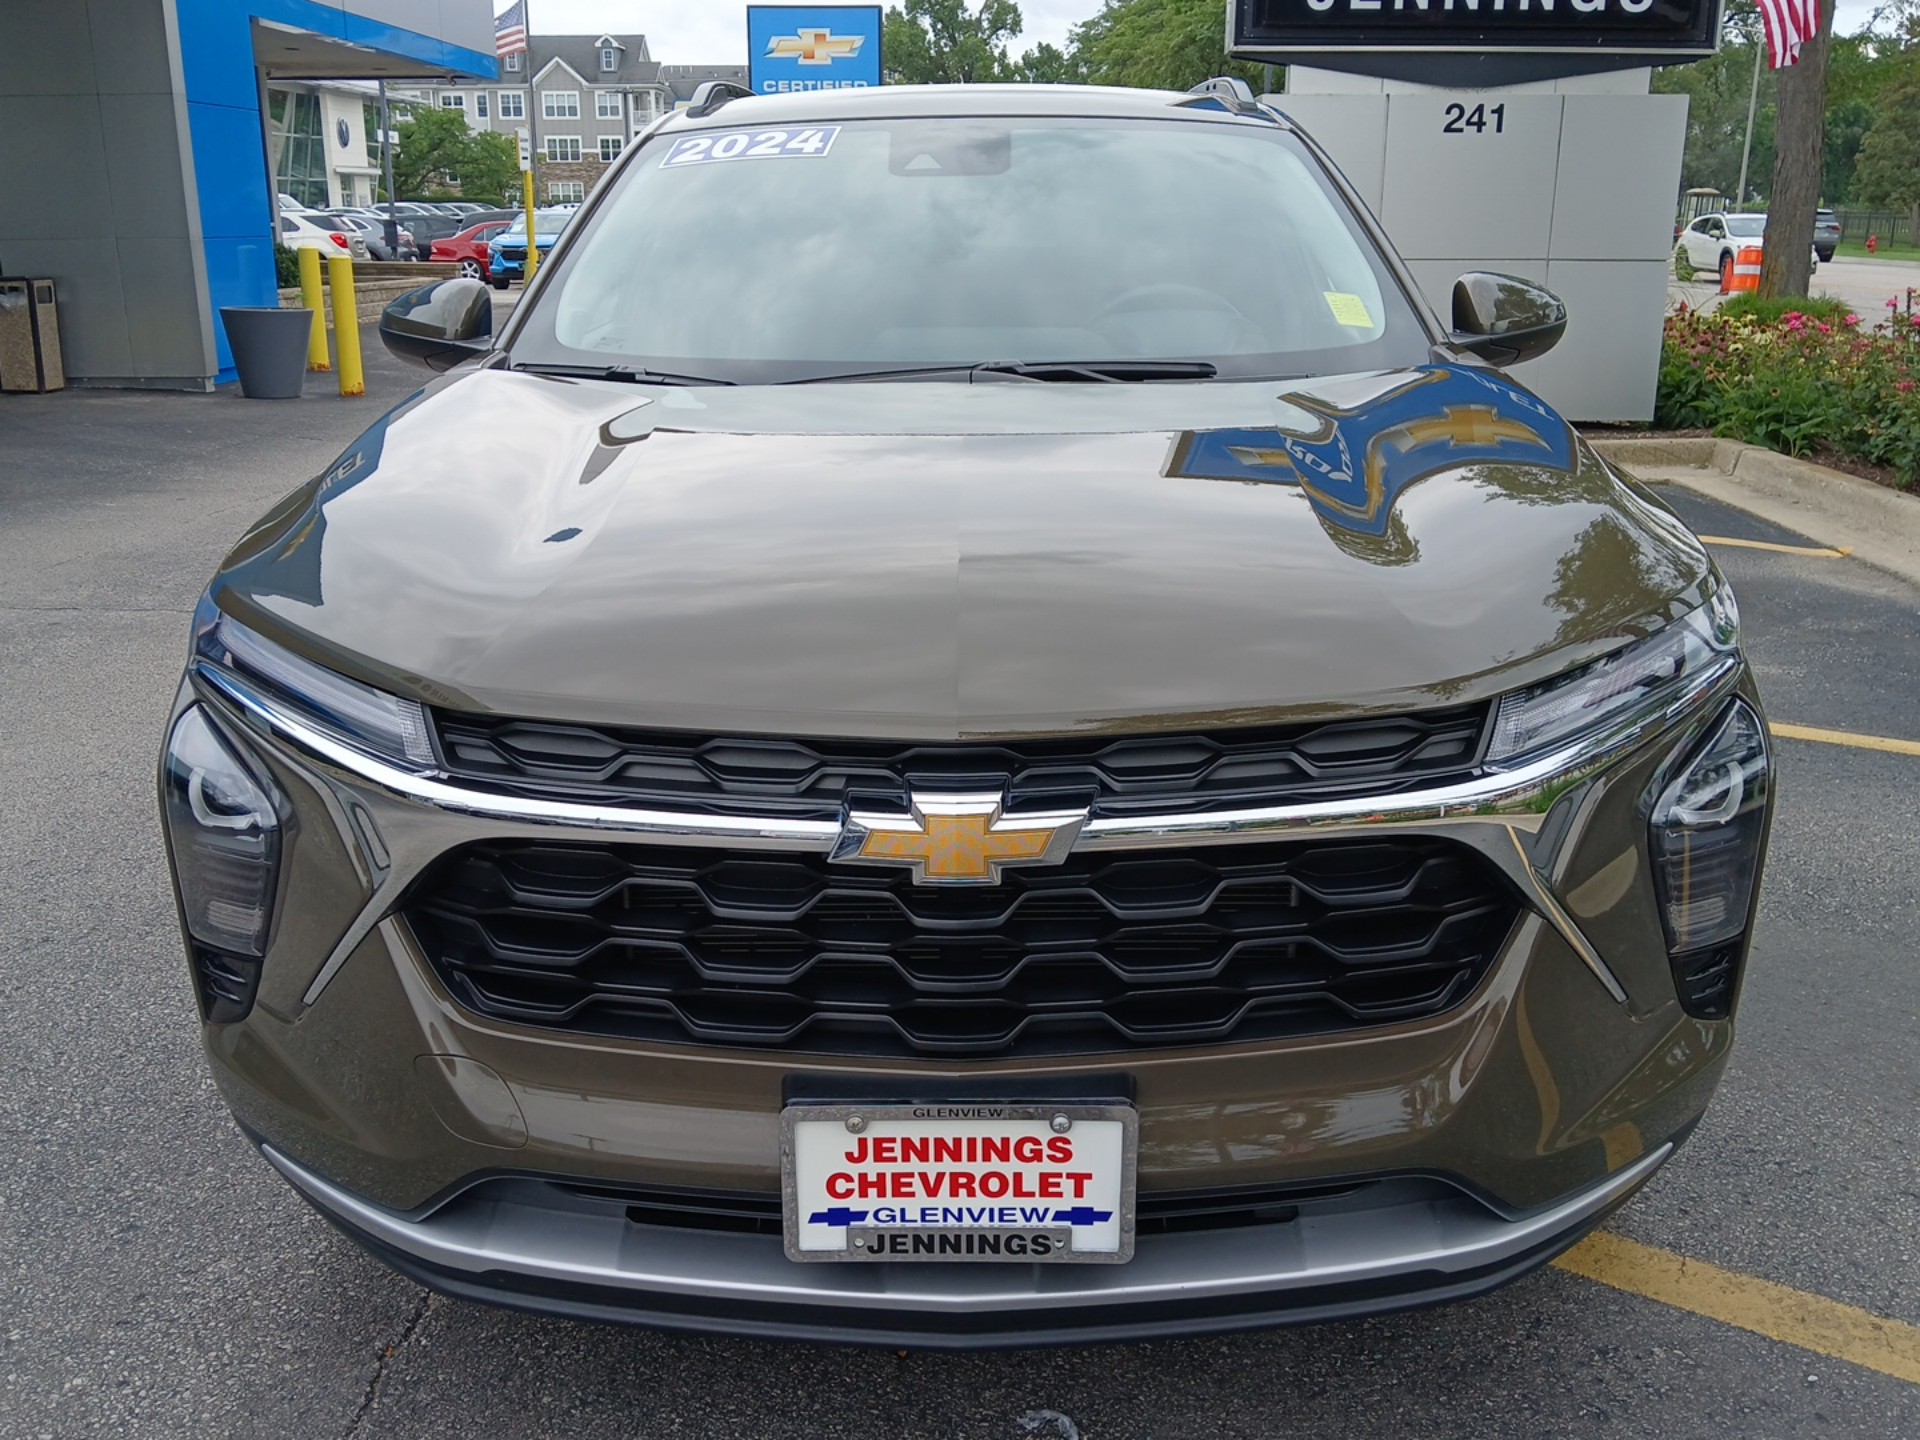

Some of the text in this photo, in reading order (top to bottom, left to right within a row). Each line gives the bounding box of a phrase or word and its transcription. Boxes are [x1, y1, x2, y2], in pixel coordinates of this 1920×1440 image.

[763, 80, 868, 92] CERTIFIED
[1443, 103, 1505, 133] 241
[670, 129, 825, 163] 2024
[912, 1107, 1005, 1118] GLENVIEW
[845, 1136, 1074, 1164] JENNINGS
[825, 1171, 1093, 1200] CHEVROLET
[872, 1207, 1050, 1223] GLENVIEW
[866, 1233, 1052, 1255] JENNINGS
